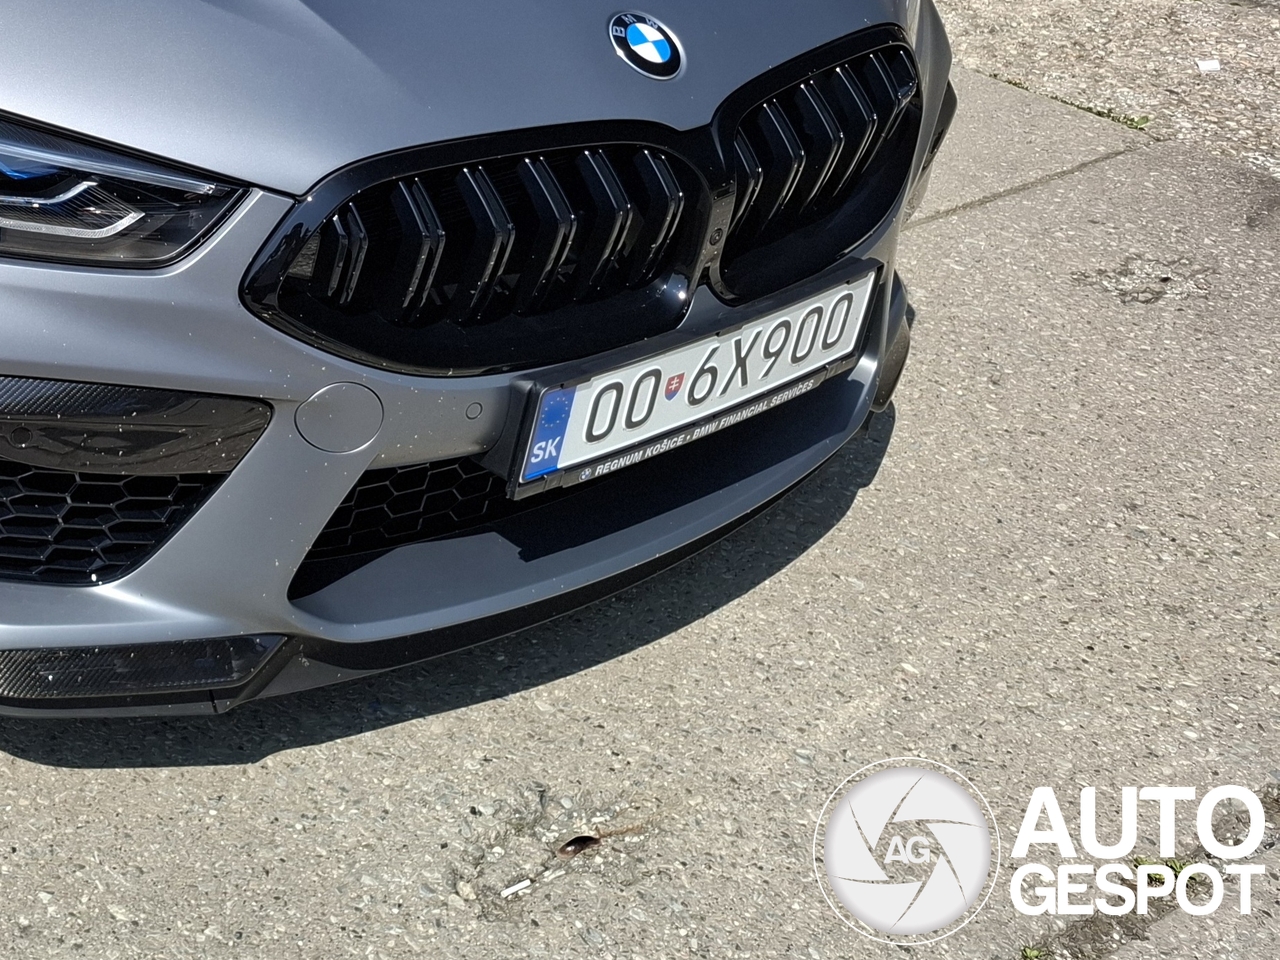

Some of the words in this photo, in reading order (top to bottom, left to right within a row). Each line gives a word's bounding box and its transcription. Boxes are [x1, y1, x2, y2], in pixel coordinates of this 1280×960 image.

[612, 13, 659, 39] BMW
[686, 290, 854, 407] 6X900
[530, 436, 561, 464] SK
[595, 450, 643, 477] REGNUM
[644, 433, 685, 459] KOŠICE
[692, 420, 720, 440] BMW
[719, 399, 769, 431] FINANCIAL
